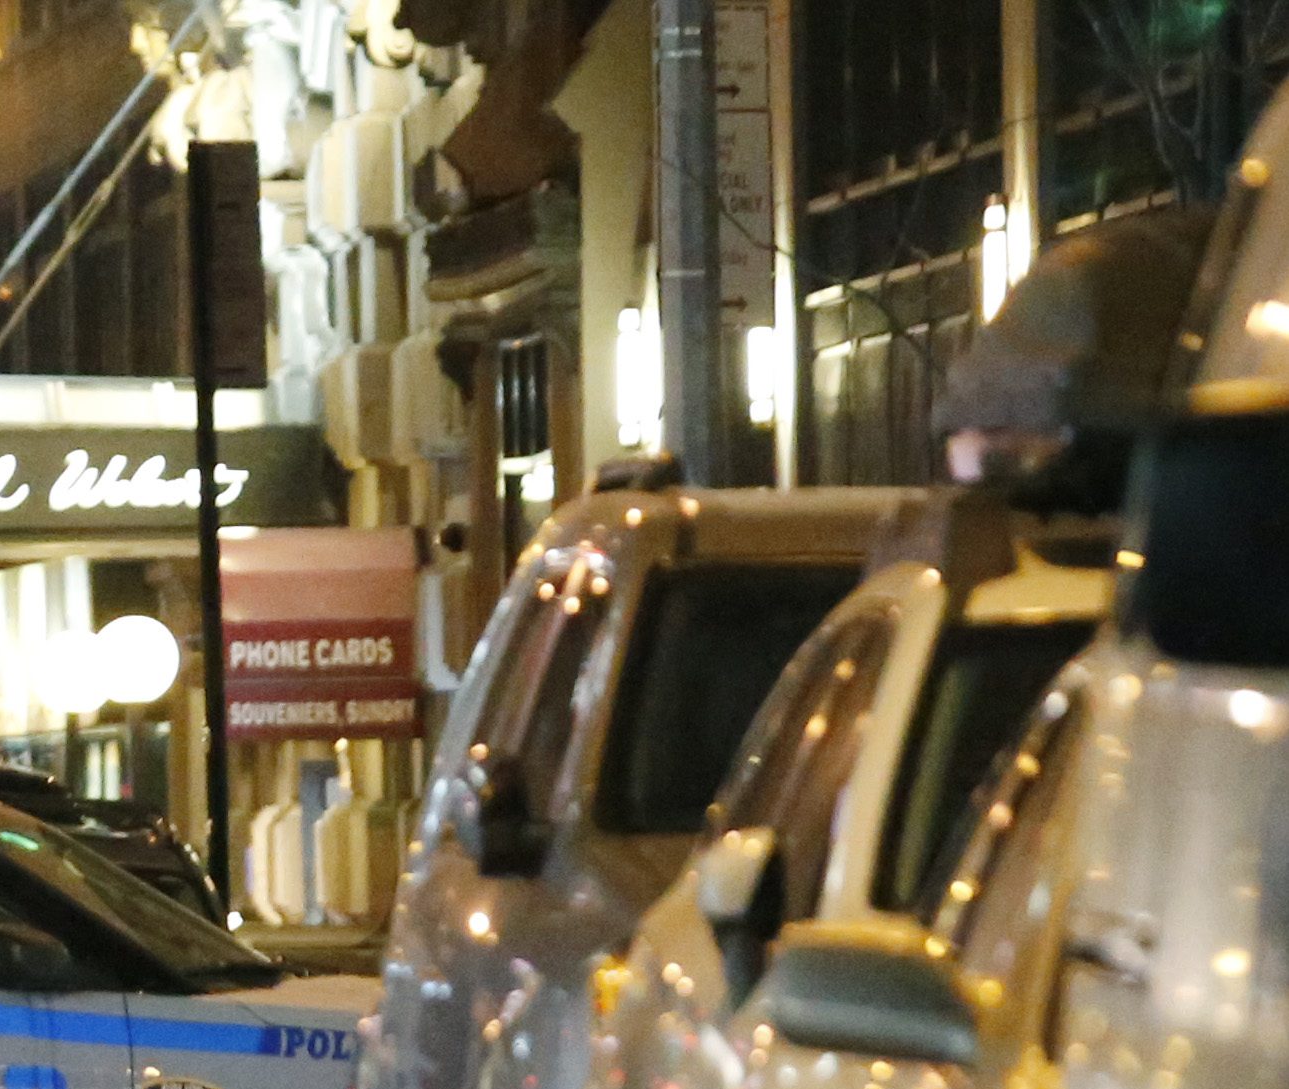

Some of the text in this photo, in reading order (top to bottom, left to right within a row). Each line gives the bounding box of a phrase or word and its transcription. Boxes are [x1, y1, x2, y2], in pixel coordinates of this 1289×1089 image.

[229, 635, 393, 671] PHONE CARDS
[284, 1026, 352, 1060] POL
